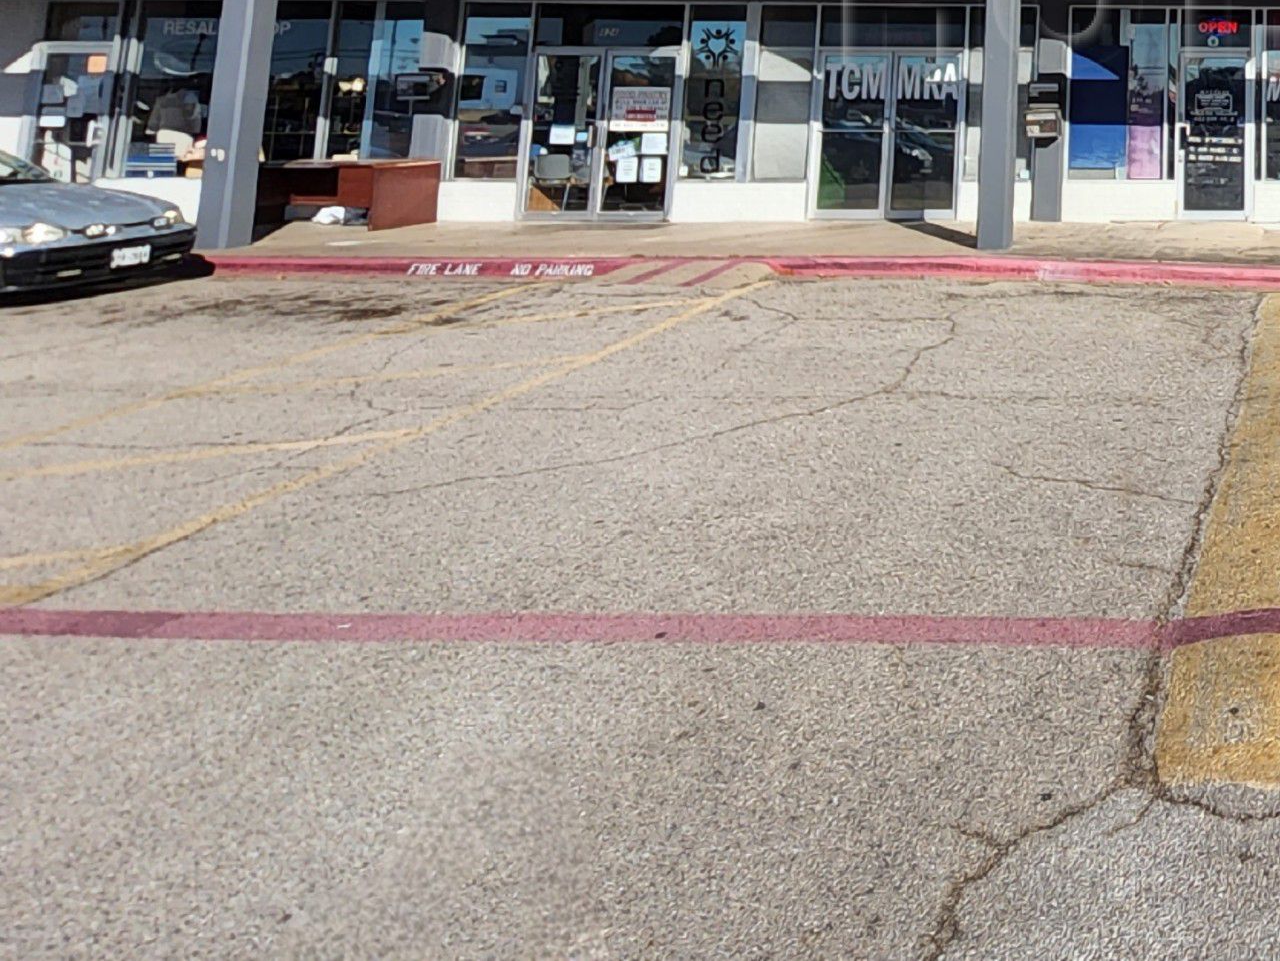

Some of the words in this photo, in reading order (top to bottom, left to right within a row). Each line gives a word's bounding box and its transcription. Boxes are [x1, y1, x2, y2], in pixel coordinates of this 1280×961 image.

[162, 19, 218, 36] RESAL
[1198, 20, 1238, 35] OPEN
[826, 61, 888, 100] TCM
[700, 78, 725, 174] need
[406, 262, 441, 276] FIRE
[443, 262, 483, 276] LANE
[510, 263, 531, 276] NO
[535, 263, 595, 277] PARKING
